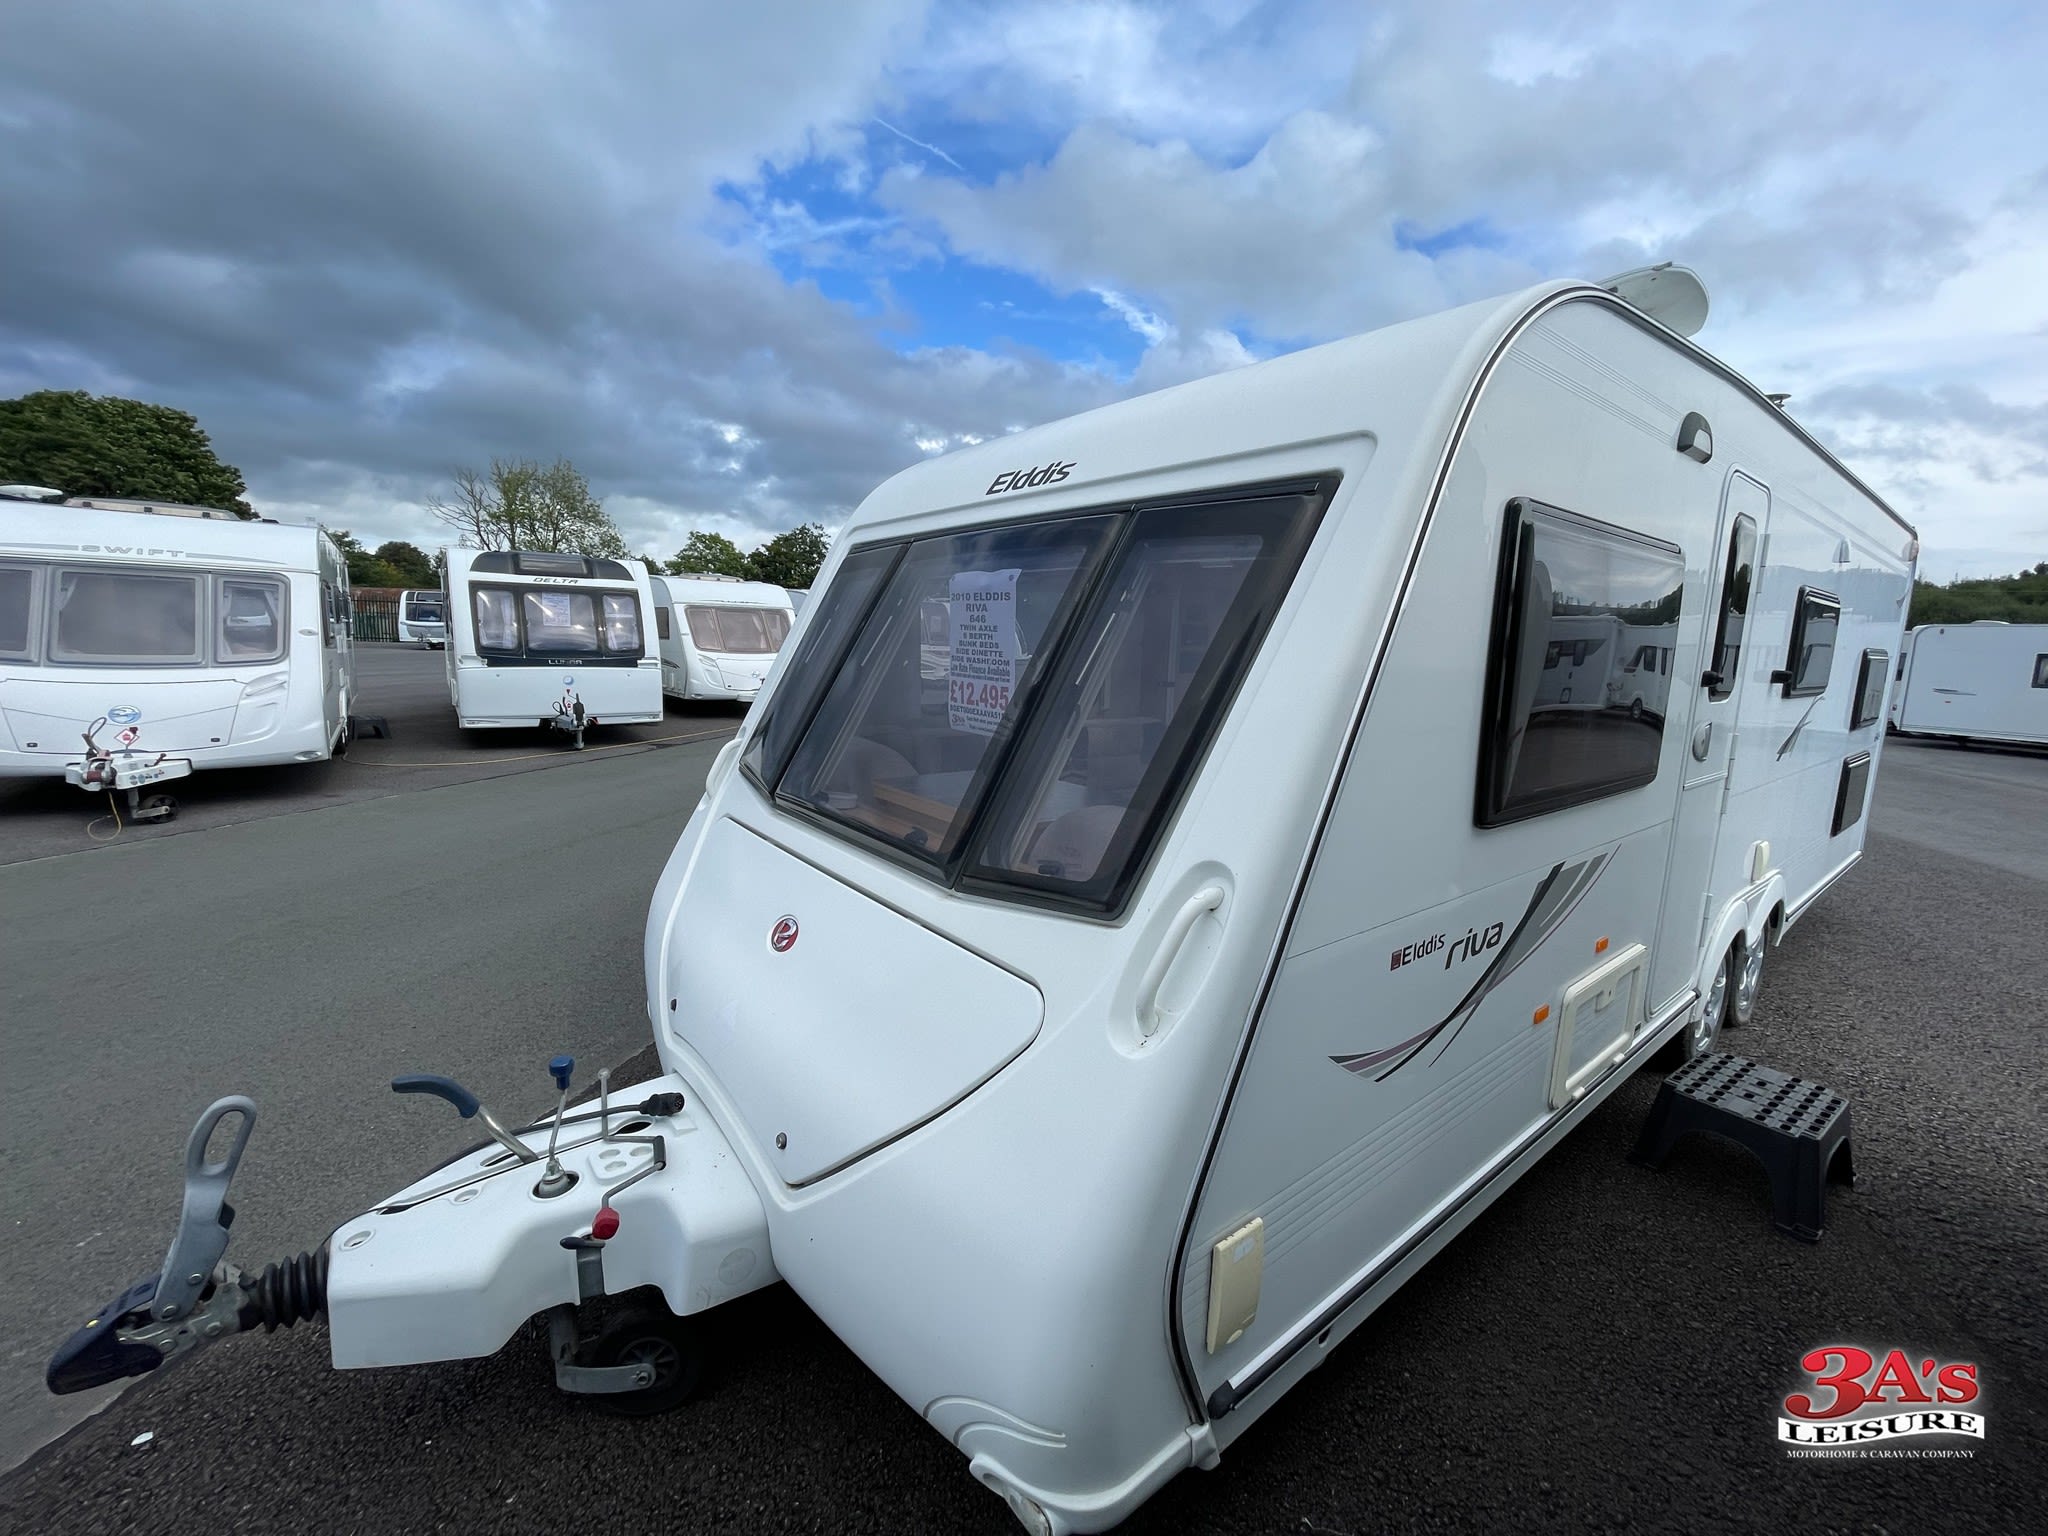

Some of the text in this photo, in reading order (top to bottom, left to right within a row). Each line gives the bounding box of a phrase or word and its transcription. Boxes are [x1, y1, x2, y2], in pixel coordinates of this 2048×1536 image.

[985, 460, 1078, 496] Elddis
[81, 544, 185, 558] SWIFT
[532, 577, 579, 585] DELTA
[950, 591, 1012, 602] 2010 ELDDIS
[966, 603, 988, 612] RIVA
[969, 614, 987, 623] 646
[959, 624, 999, 633] TWIN AXLE
[969, 632, 994, 641] BERTH
[958, 640, 1000, 650] BUNK BEDS
[971, 649, 1004, 658] DINETTE
[1402, 921, 1504, 971] Elddis riva
